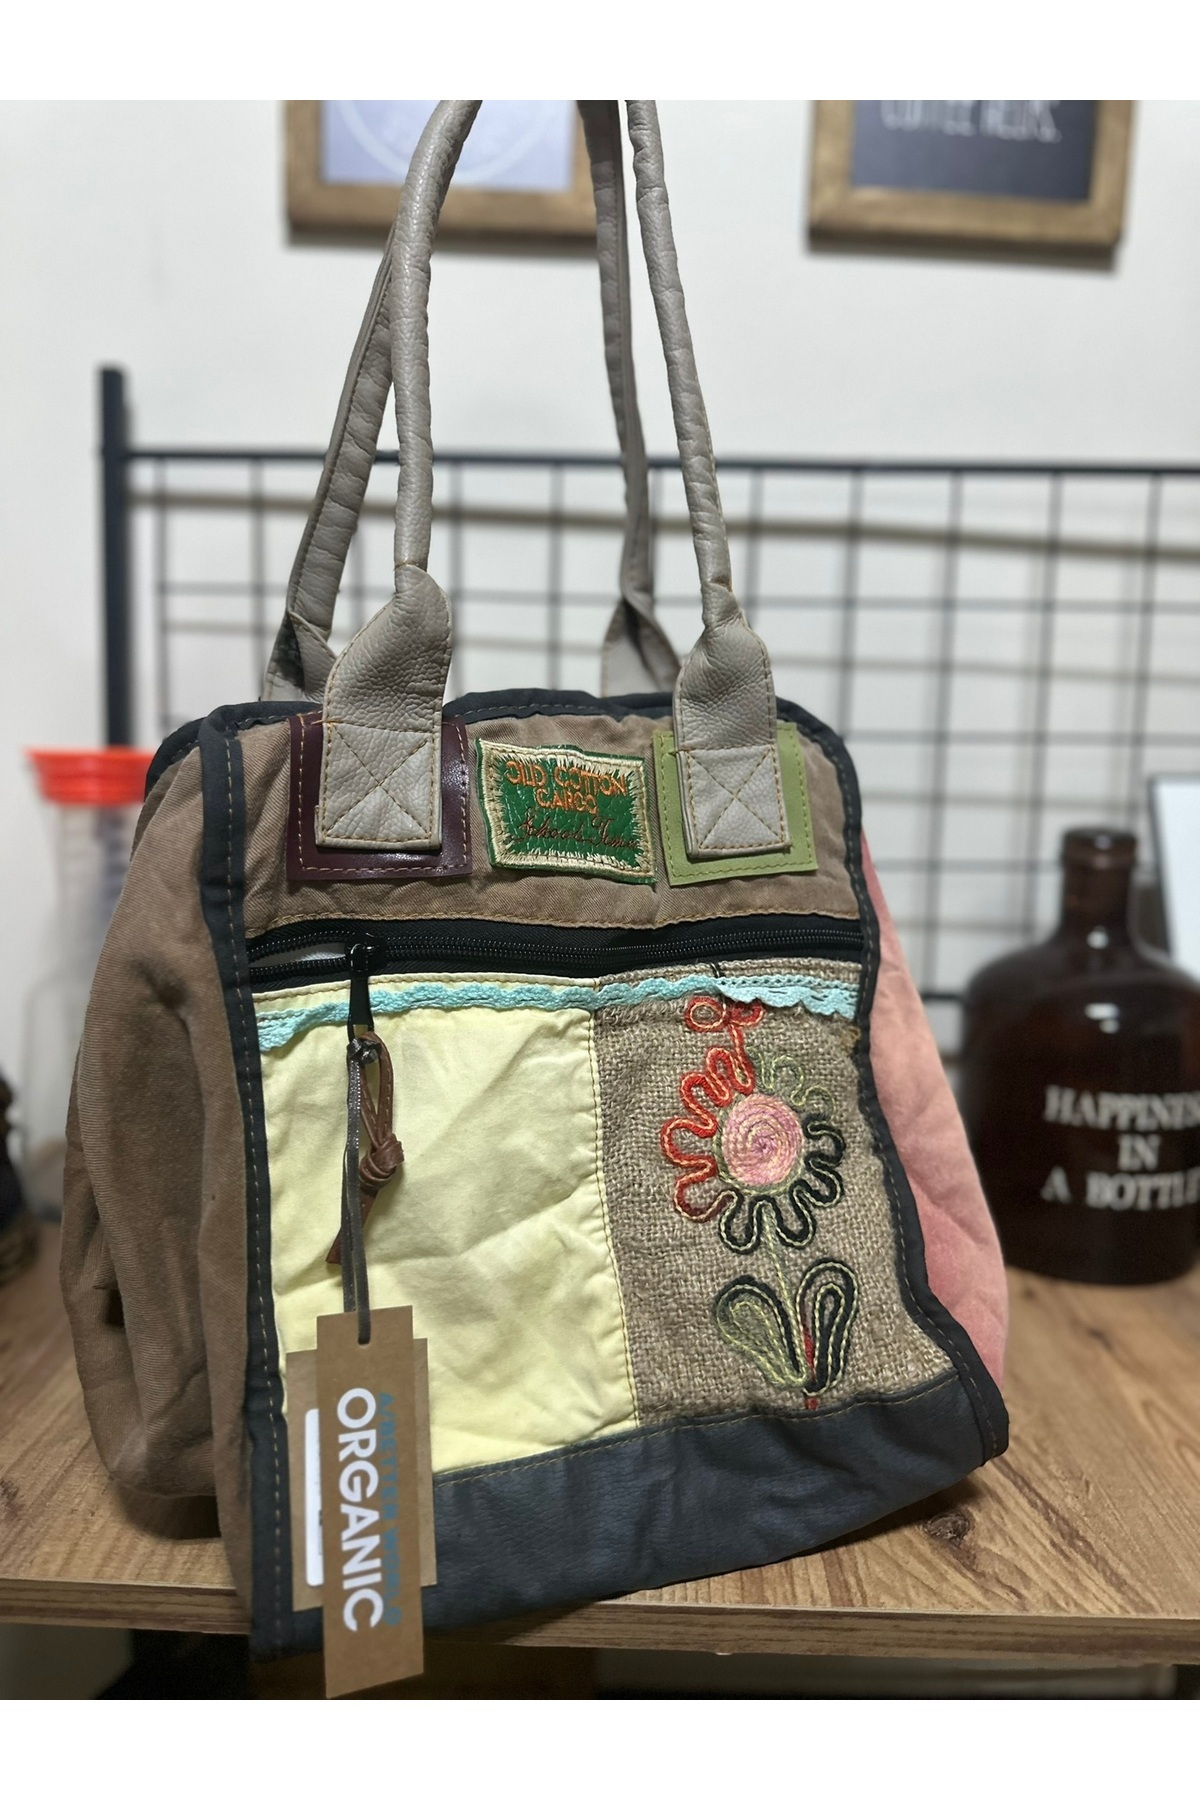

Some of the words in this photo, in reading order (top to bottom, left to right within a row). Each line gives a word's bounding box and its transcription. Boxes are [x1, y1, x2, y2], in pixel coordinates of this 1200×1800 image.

[506, 760, 547, 787] OLD
[554, 765, 628, 797] COTTON
[536, 787, 598, 815] CARGO
[1117, 1133, 1161, 1171] IN
[1040, 1166, 1071, 1203] A
[337, 1387, 384, 1632] ORGANIC
[383, 1526, 403, 1626] WORLD
